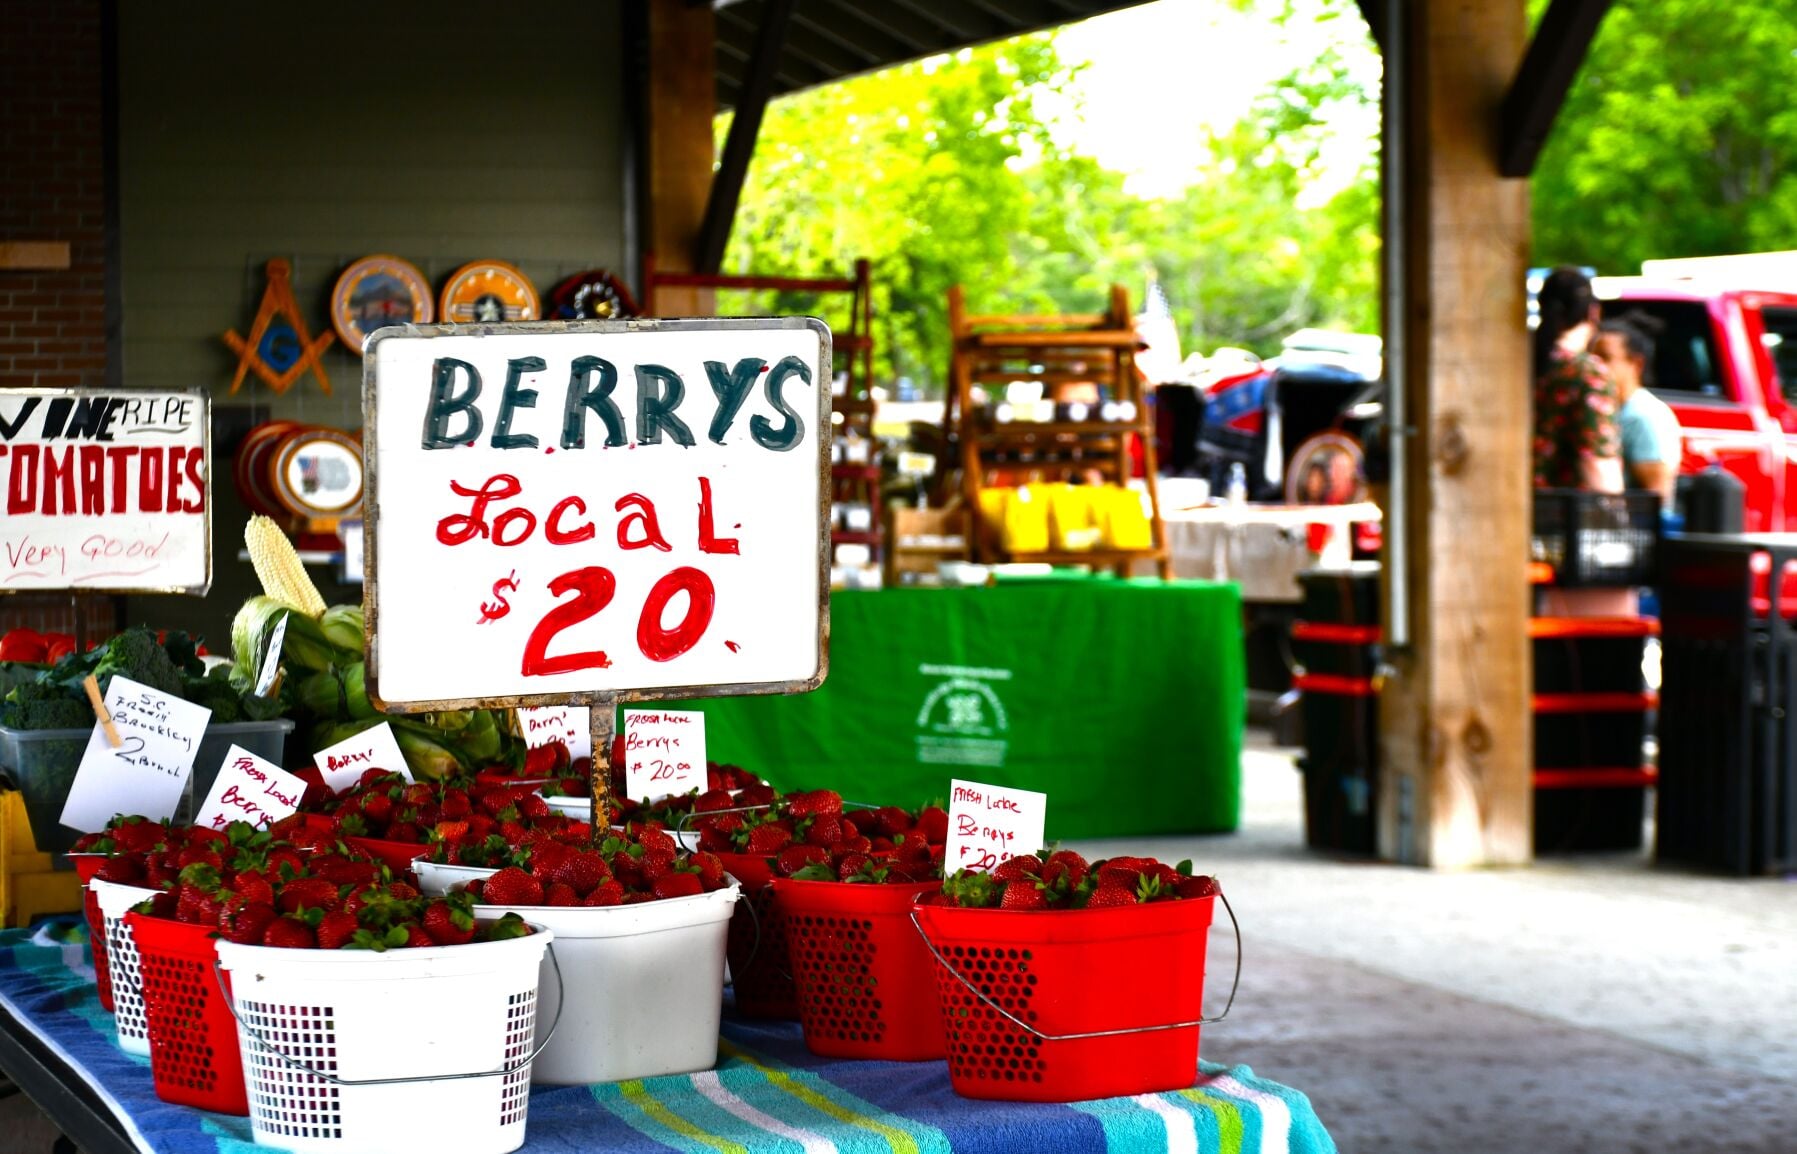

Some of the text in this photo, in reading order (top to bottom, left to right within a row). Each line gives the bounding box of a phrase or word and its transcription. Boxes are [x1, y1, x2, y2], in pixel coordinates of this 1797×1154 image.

[121, 396, 194, 426] RIPE
[421, 355, 812, 451] BERRYS
[0, 443, 205, 517] OMATOES
